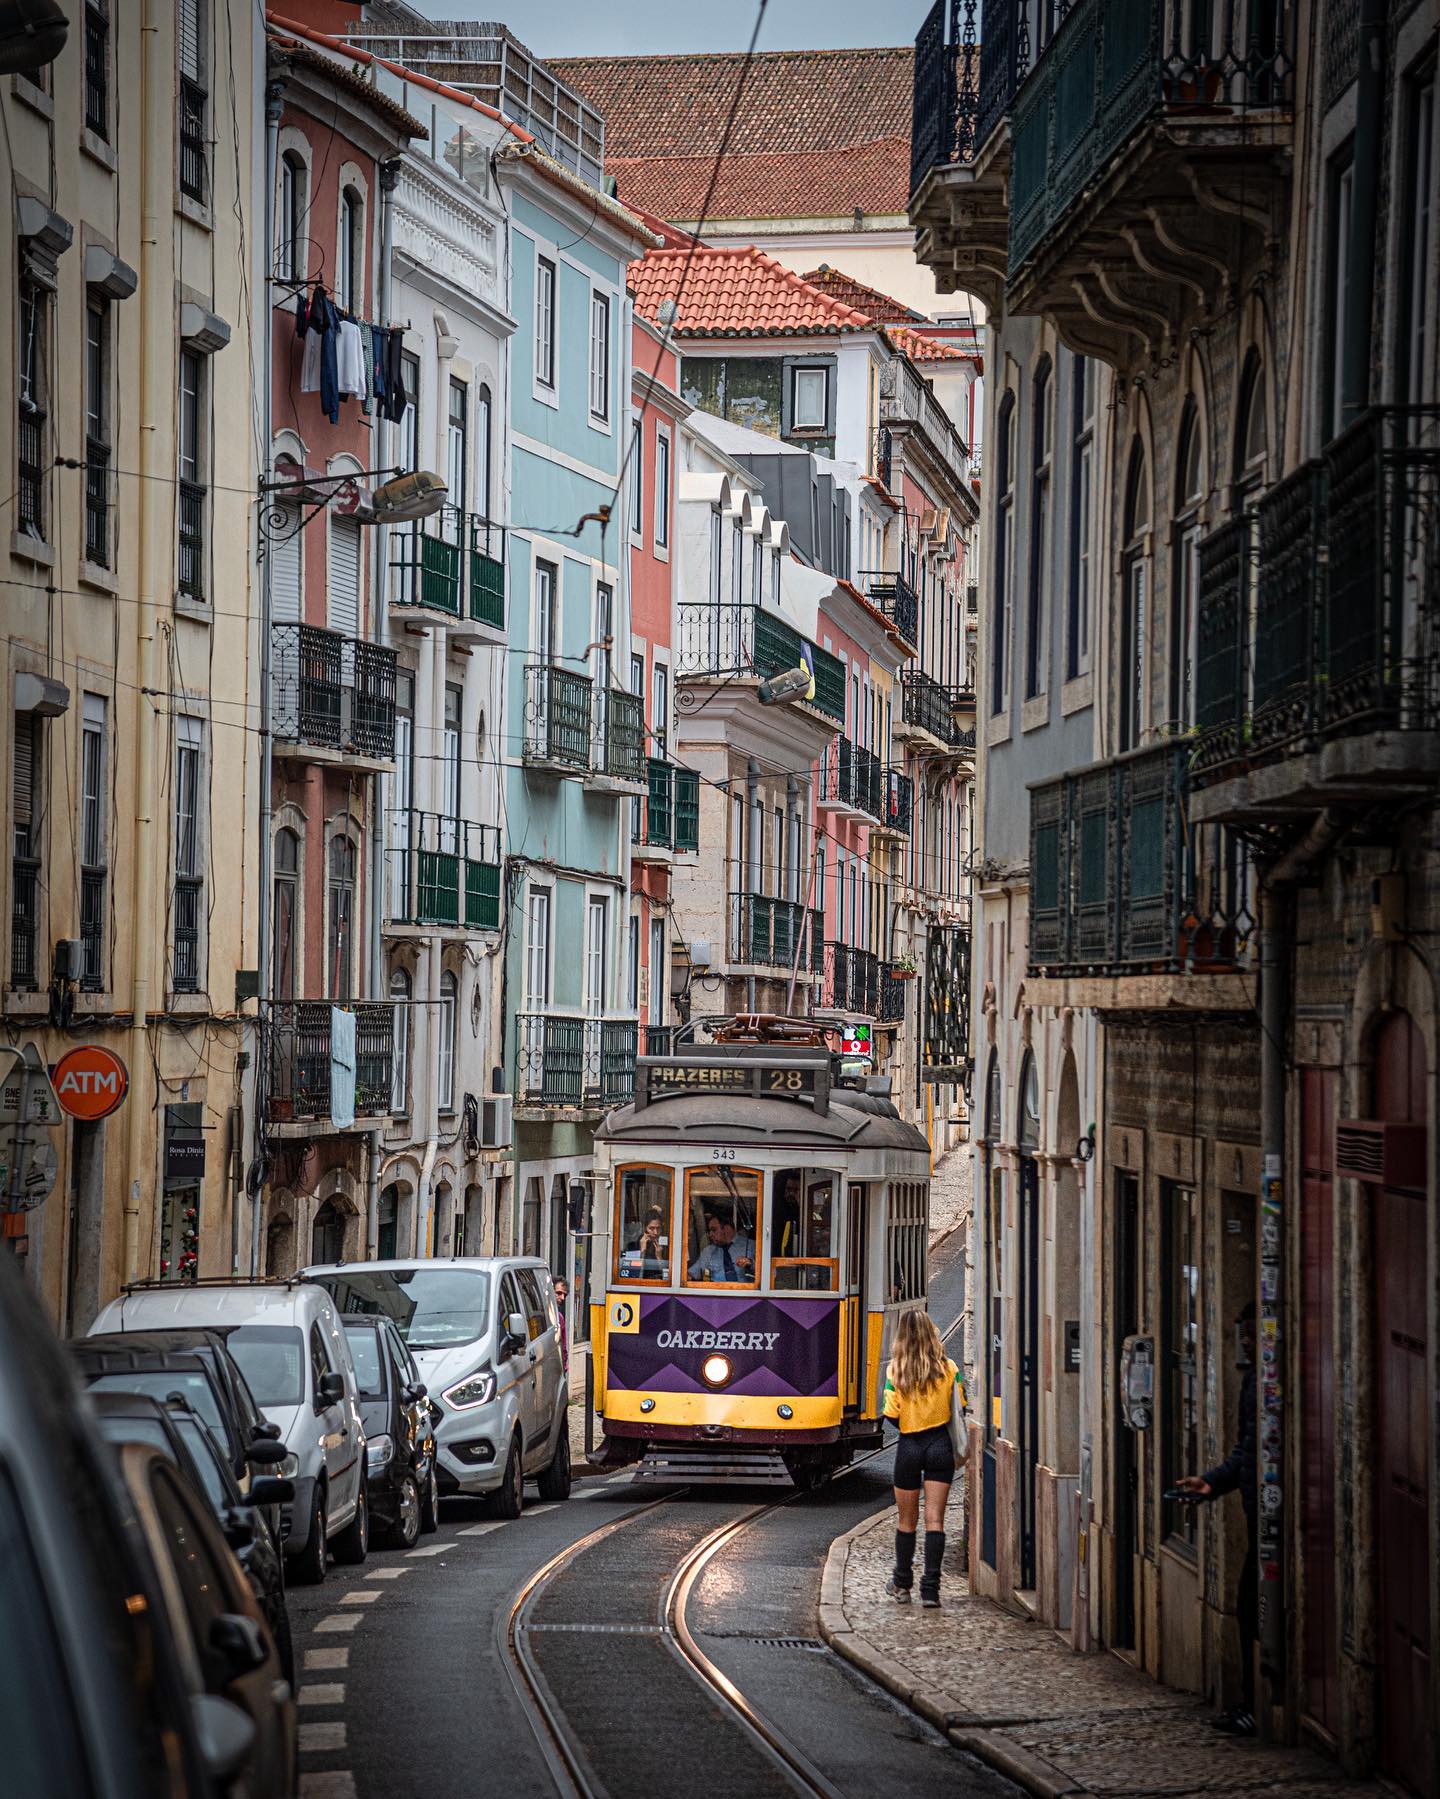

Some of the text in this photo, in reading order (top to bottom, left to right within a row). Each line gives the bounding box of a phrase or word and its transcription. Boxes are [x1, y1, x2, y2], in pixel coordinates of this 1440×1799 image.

[59, 1071, 117, 1094] ATM
[651, 1067, 745, 1082] PRAZERES
[770, 1070, 803, 1090] 28
[712, 1149, 735, 1160] 543
[657, 1329, 780, 1350] OAKBERRY
